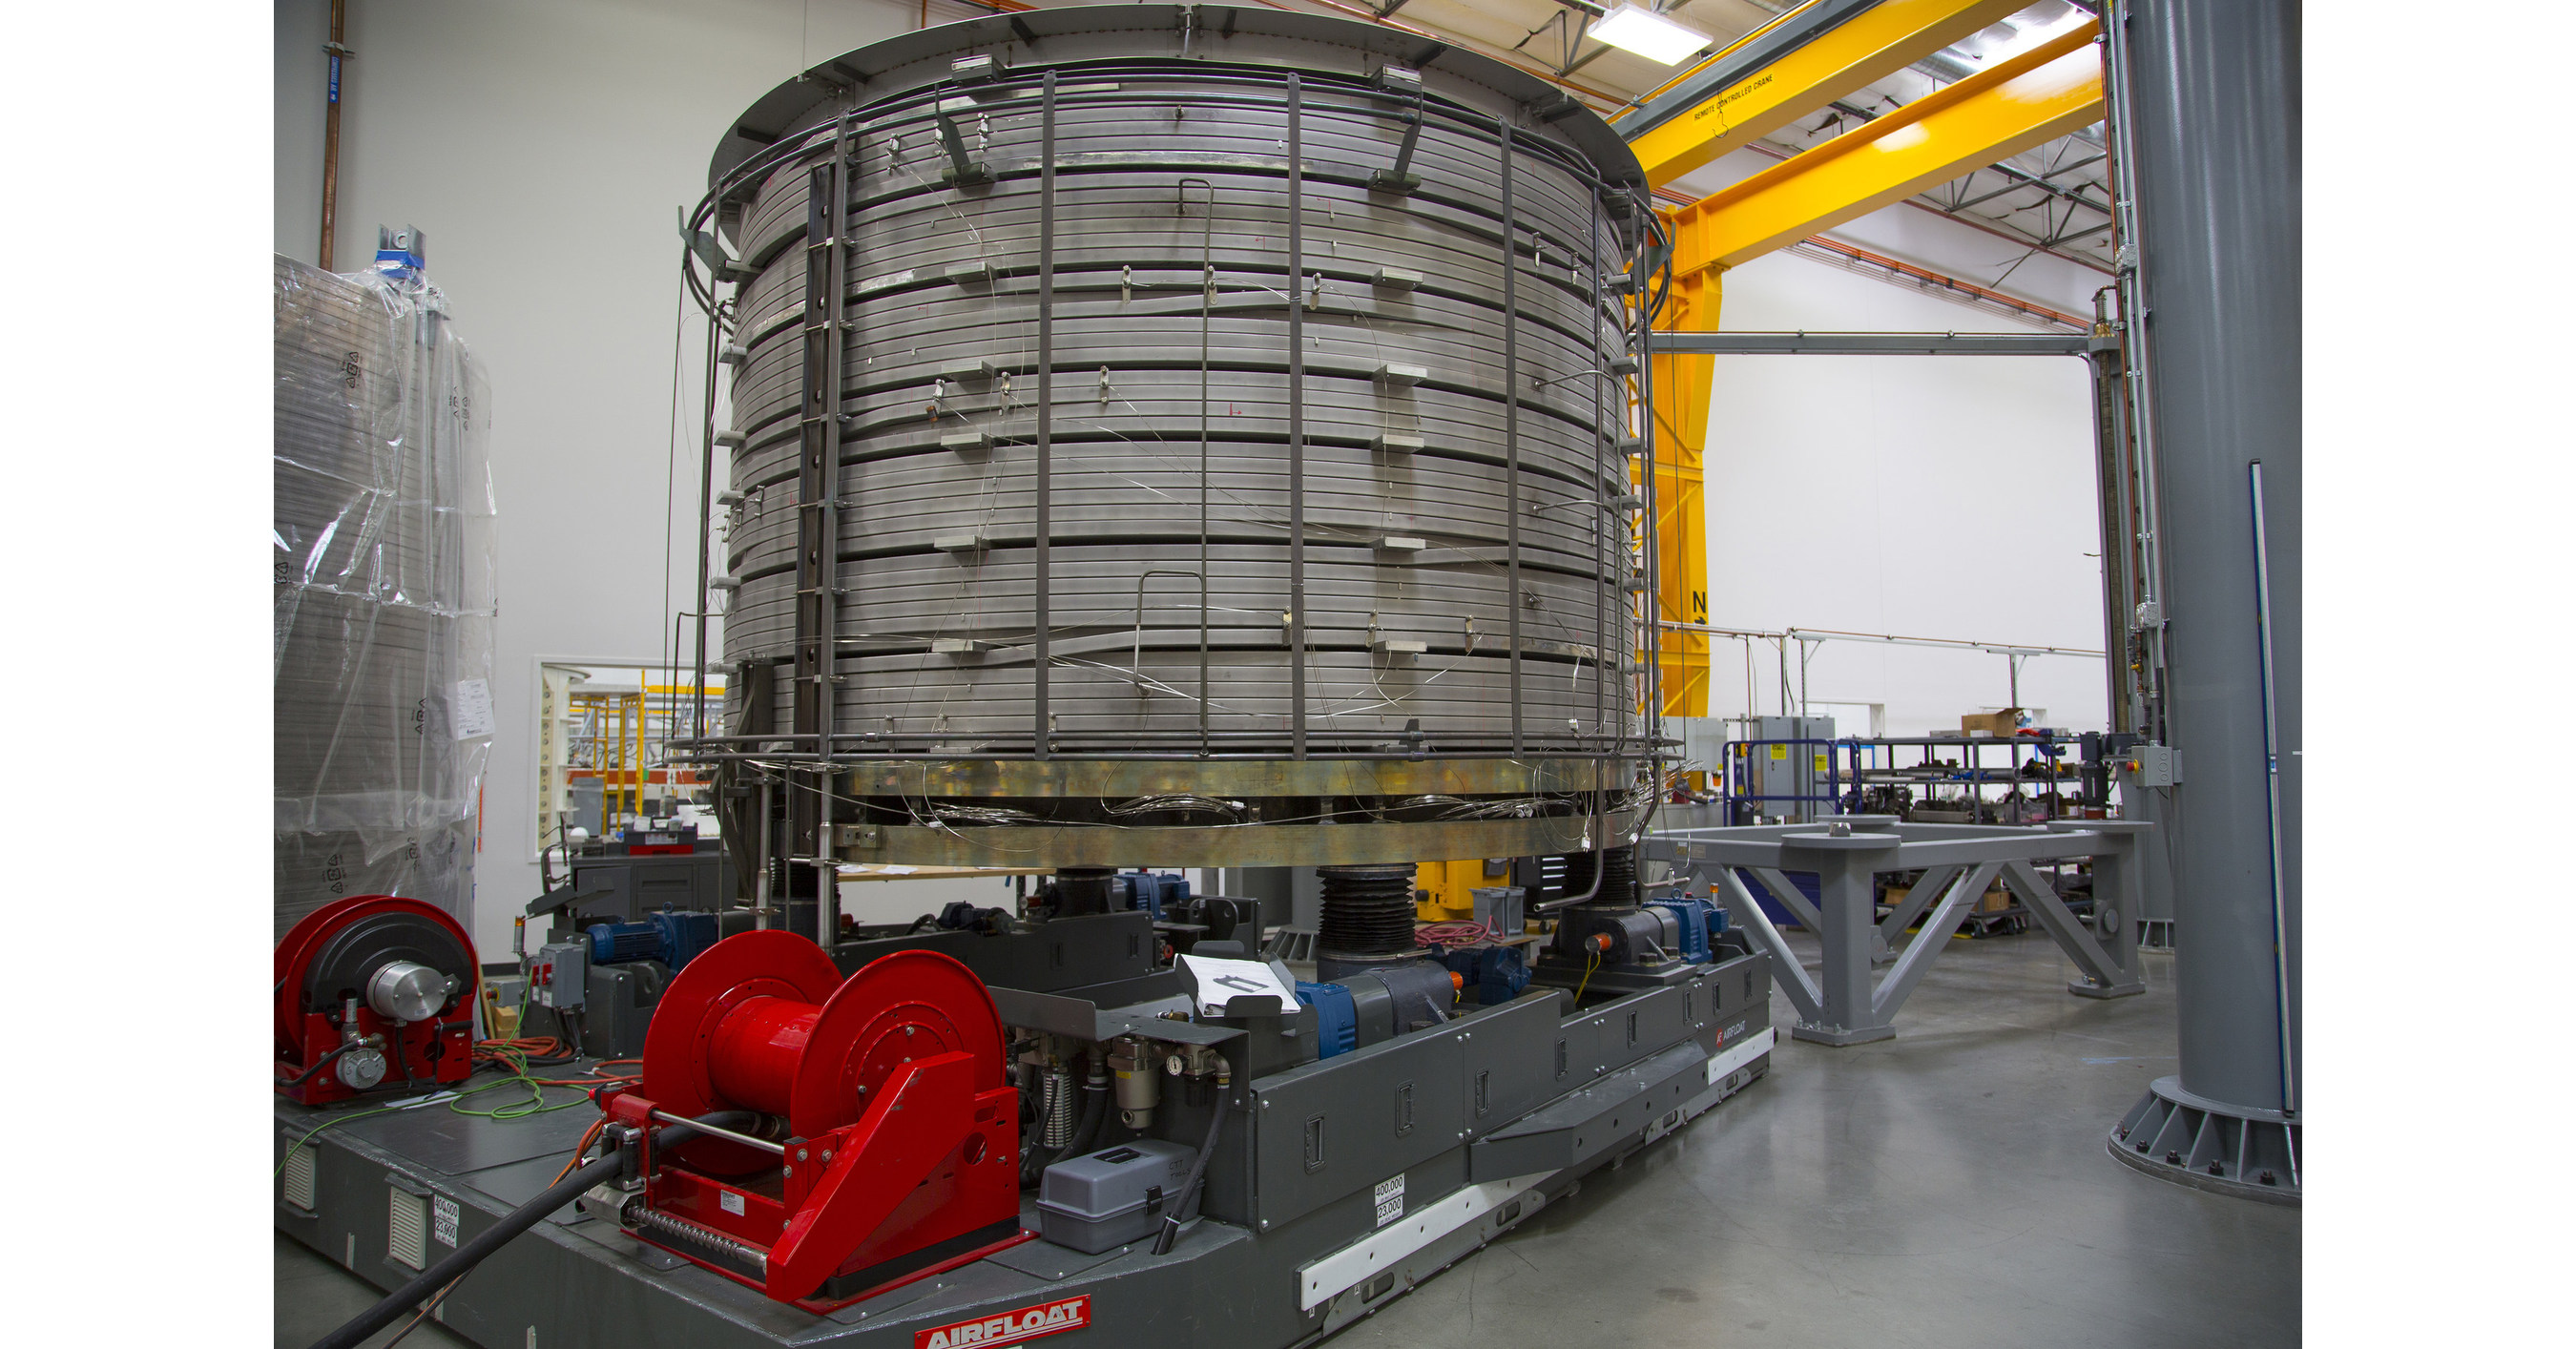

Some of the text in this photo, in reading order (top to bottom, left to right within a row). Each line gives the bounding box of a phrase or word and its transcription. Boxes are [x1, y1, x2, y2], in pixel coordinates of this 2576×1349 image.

[1693, 73, 1774, 121] REMOTE CONTROLLED CRANE
[1693, 590, 1706, 613] N
[1723, 1020, 1746, 1041] AIRFLOAT
[1376, 1176, 1403, 1196] 400,000
[435, 1197, 458, 1217] 400,000
[1378, 1198, 1402, 1218] 23,000
[926, 1299, 1084, 1349] AIRFLOAT
